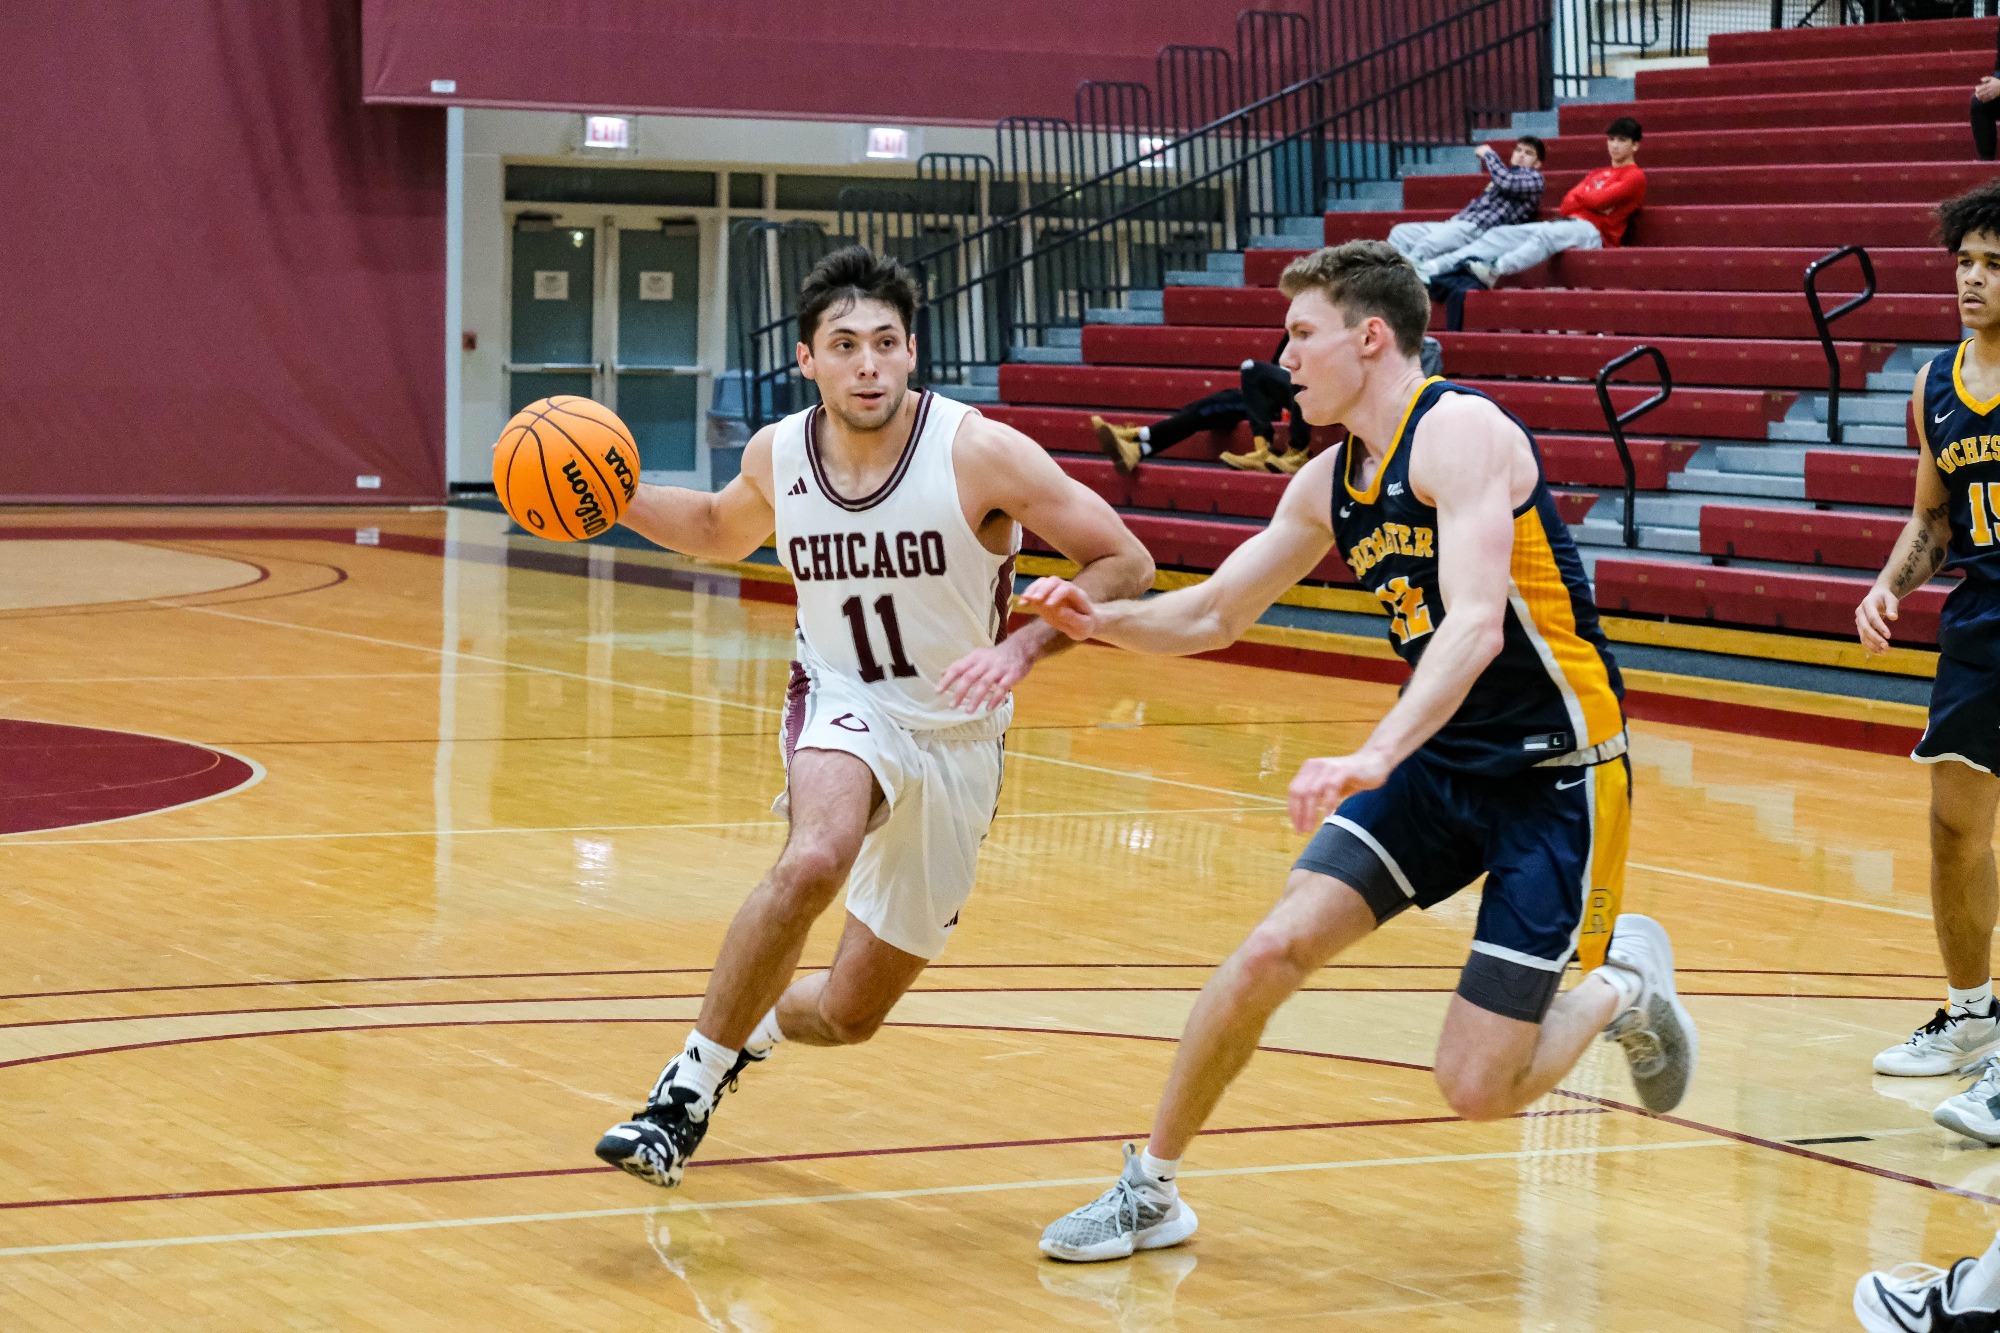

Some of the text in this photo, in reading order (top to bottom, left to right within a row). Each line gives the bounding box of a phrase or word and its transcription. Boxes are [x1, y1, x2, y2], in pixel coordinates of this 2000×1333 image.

[562, 458, 609, 536] Wilson
[604, 445, 635, 504] NCAA
[788, 530, 947, 582] CHICAGO
[841, 592, 919, 684] 11
